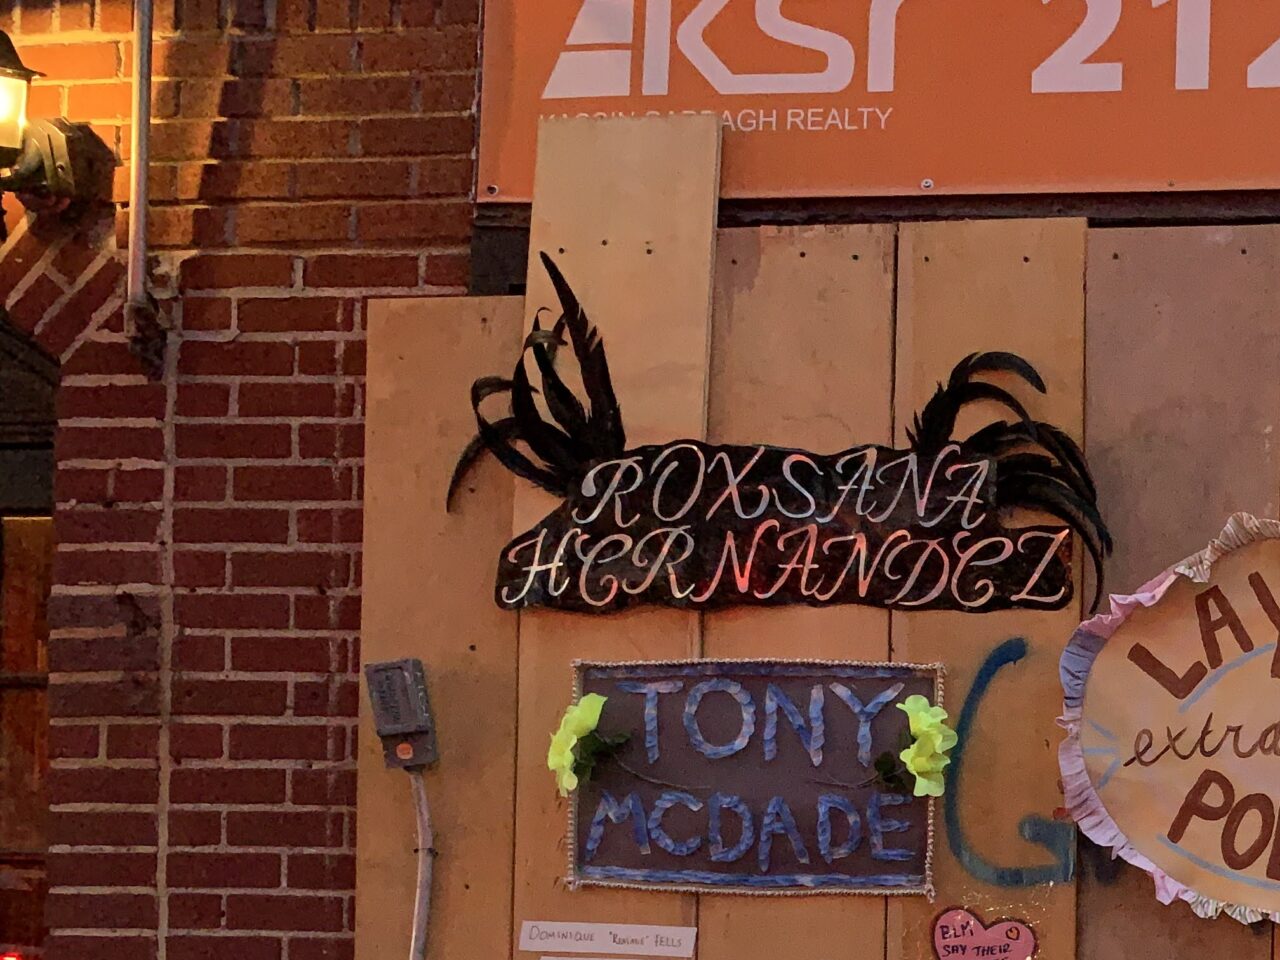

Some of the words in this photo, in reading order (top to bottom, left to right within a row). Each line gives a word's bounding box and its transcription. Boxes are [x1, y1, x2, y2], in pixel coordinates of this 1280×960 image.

[786, 107, 894, 130] REALTY
[572, 443, 991, 527] ROXSANA
[500, 519, 1070, 607] HERNANDEZ
[615, 678, 906, 768] TONY
[583, 789, 915, 873] MCDADE
[528, 924, 595, 943] DOMINIQUE
[654, 934, 683, 948] FELLS
[939, 920, 974, 940] BLM
[942, 944, 968, 958] SAY
[972, 943, 1014, 957] THEIR
